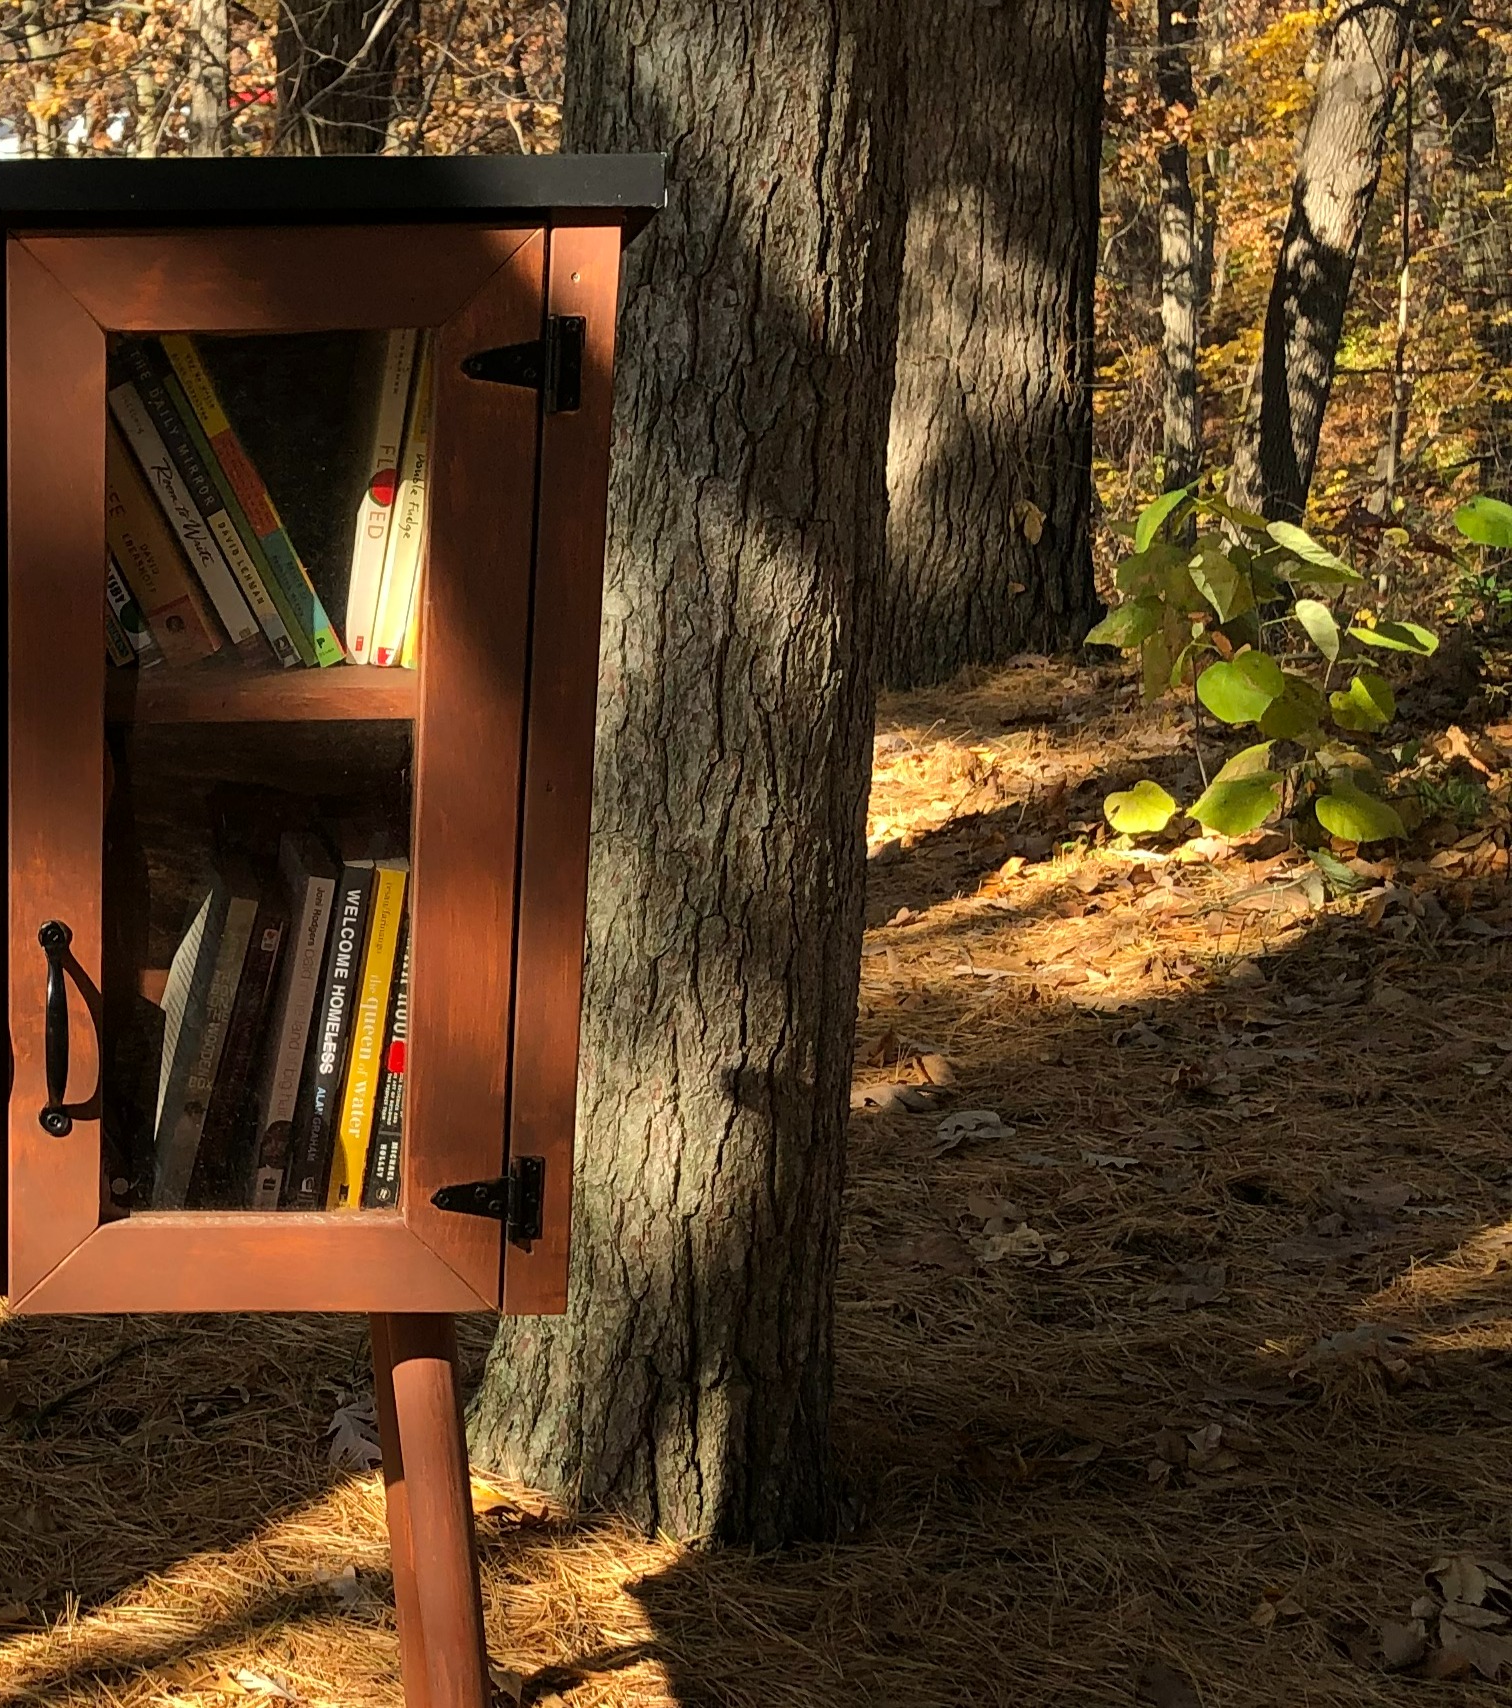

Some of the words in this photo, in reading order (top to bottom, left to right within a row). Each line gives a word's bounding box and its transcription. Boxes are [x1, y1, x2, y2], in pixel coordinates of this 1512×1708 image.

[128, 348, 152, 382] THE
[147, 386, 181, 437] DAILY
[175, 443, 216, 507] MIRROR
[148, 456, 187, 505] Room
[366, 443, 396, 540] FLED
[410, 452, 426, 496] Double
[174, 503, 192, 522] to
[396, 501, 420, 540] Fudge
[137, 543, 163, 577] DAVID
[178, 515, 222, 570] Write
[217, 521, 241, 556] DAVID
[236, 559, 266, 605] LEHMAN
[313, 886, 326, 907] Joni
[305, 908, 323, 948] Rodgers
[333, 887, 362, 981] WELCOME
[367, 974, 383, 995] the
[196, 1021, 222, 1078] WOODEN
[318, 983, 346, 1077] HOMELESS
[356, 995, 380, 1062] queen
[356, 1062, 370, 1077] of
[312, 1086, 328, 1117] ALAN
[347, 1078, 368, 1140] water
[306, 1115, 322, 1163] GRAHAM
[375, 1142, 388, 1179] HOLLEY
[385, 1140, 399, 1183] MICHAEL
